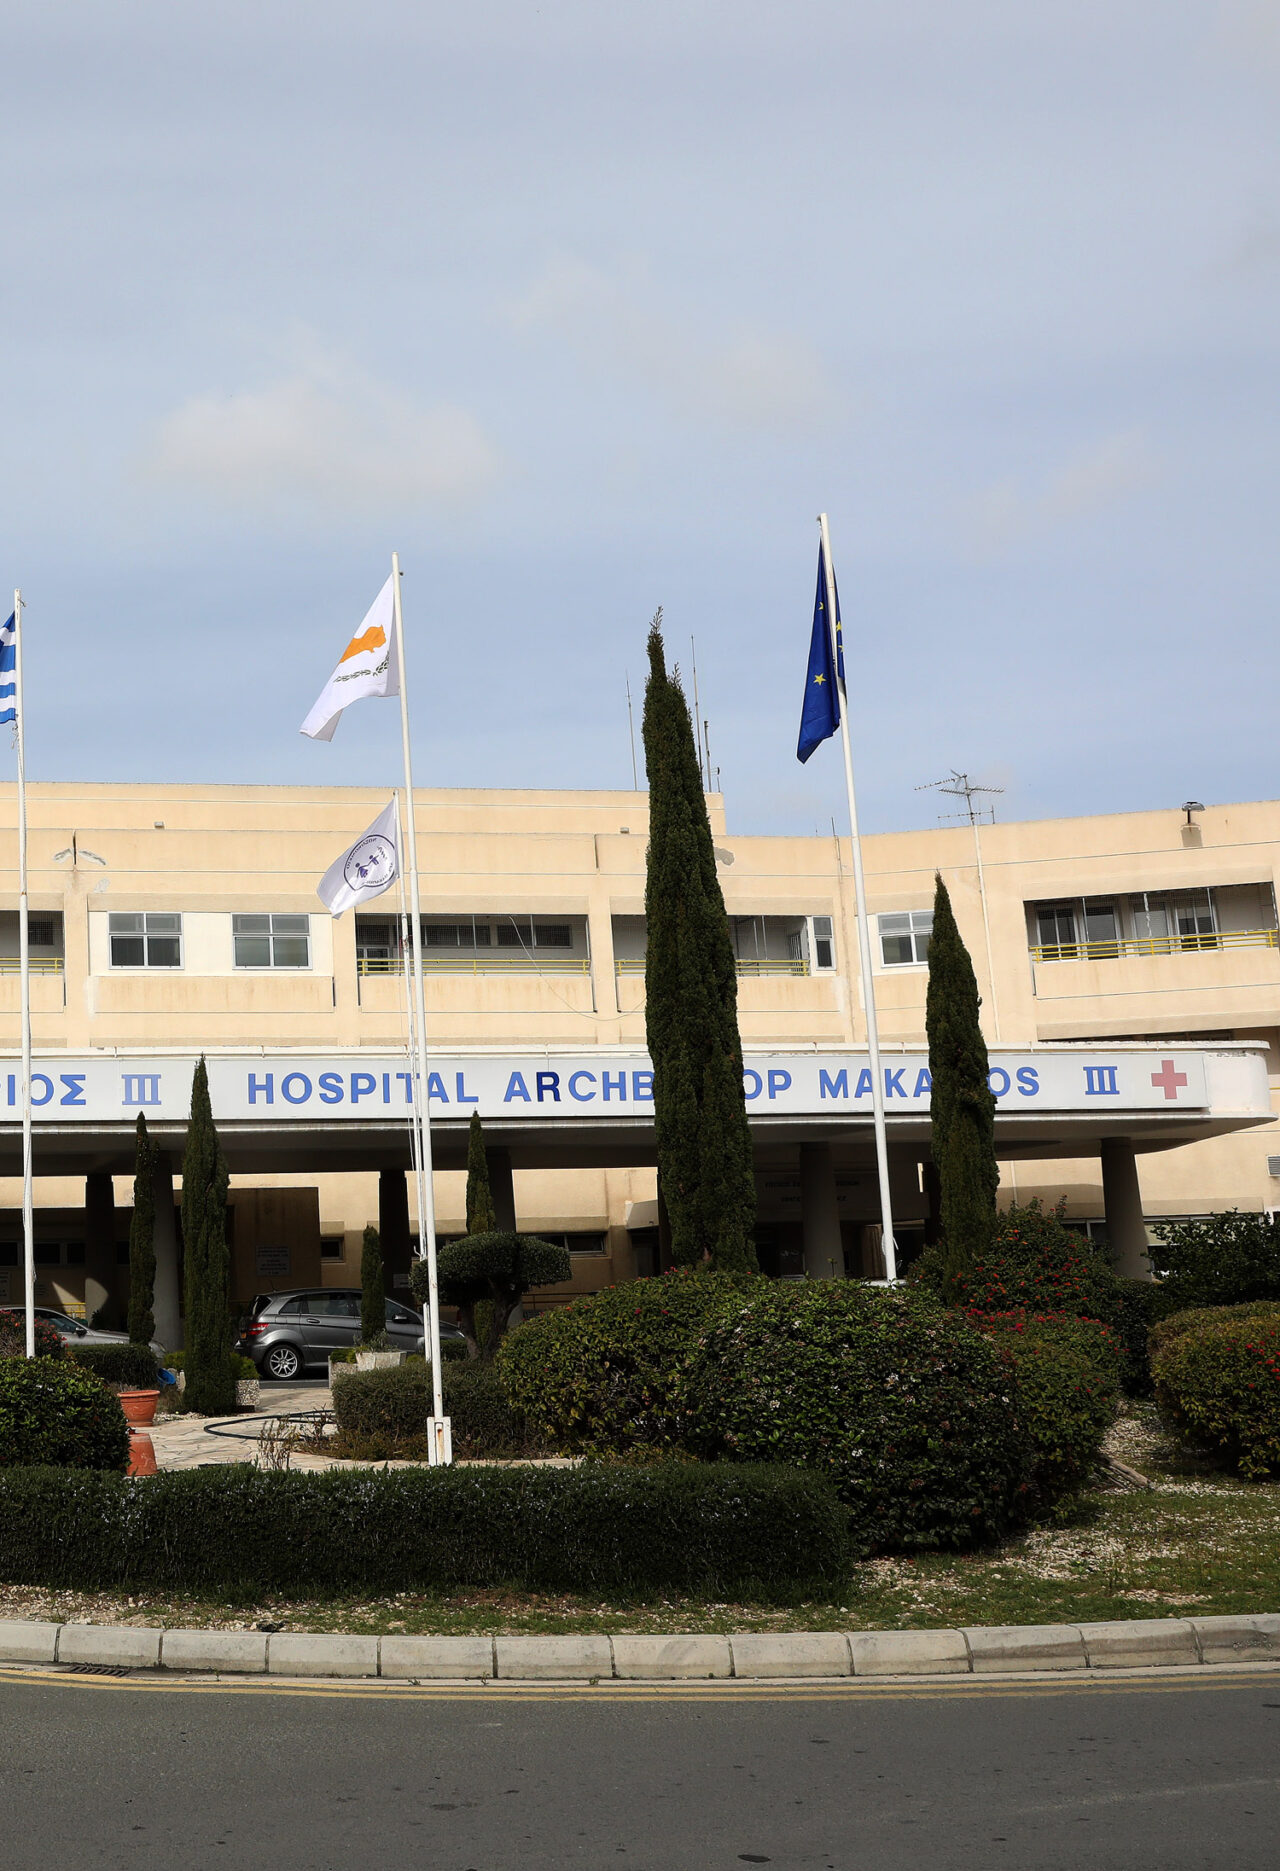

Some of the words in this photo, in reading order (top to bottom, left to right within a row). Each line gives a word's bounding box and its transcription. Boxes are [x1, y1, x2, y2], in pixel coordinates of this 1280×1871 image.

[248, 1071, 479, 1105] HOSPITAL
[504, 1068, 792, 1103] ARCHBOP
[819, 1065, 1040, 1099] MAKAOS
[1083, 1065, 1121, 1095] III
